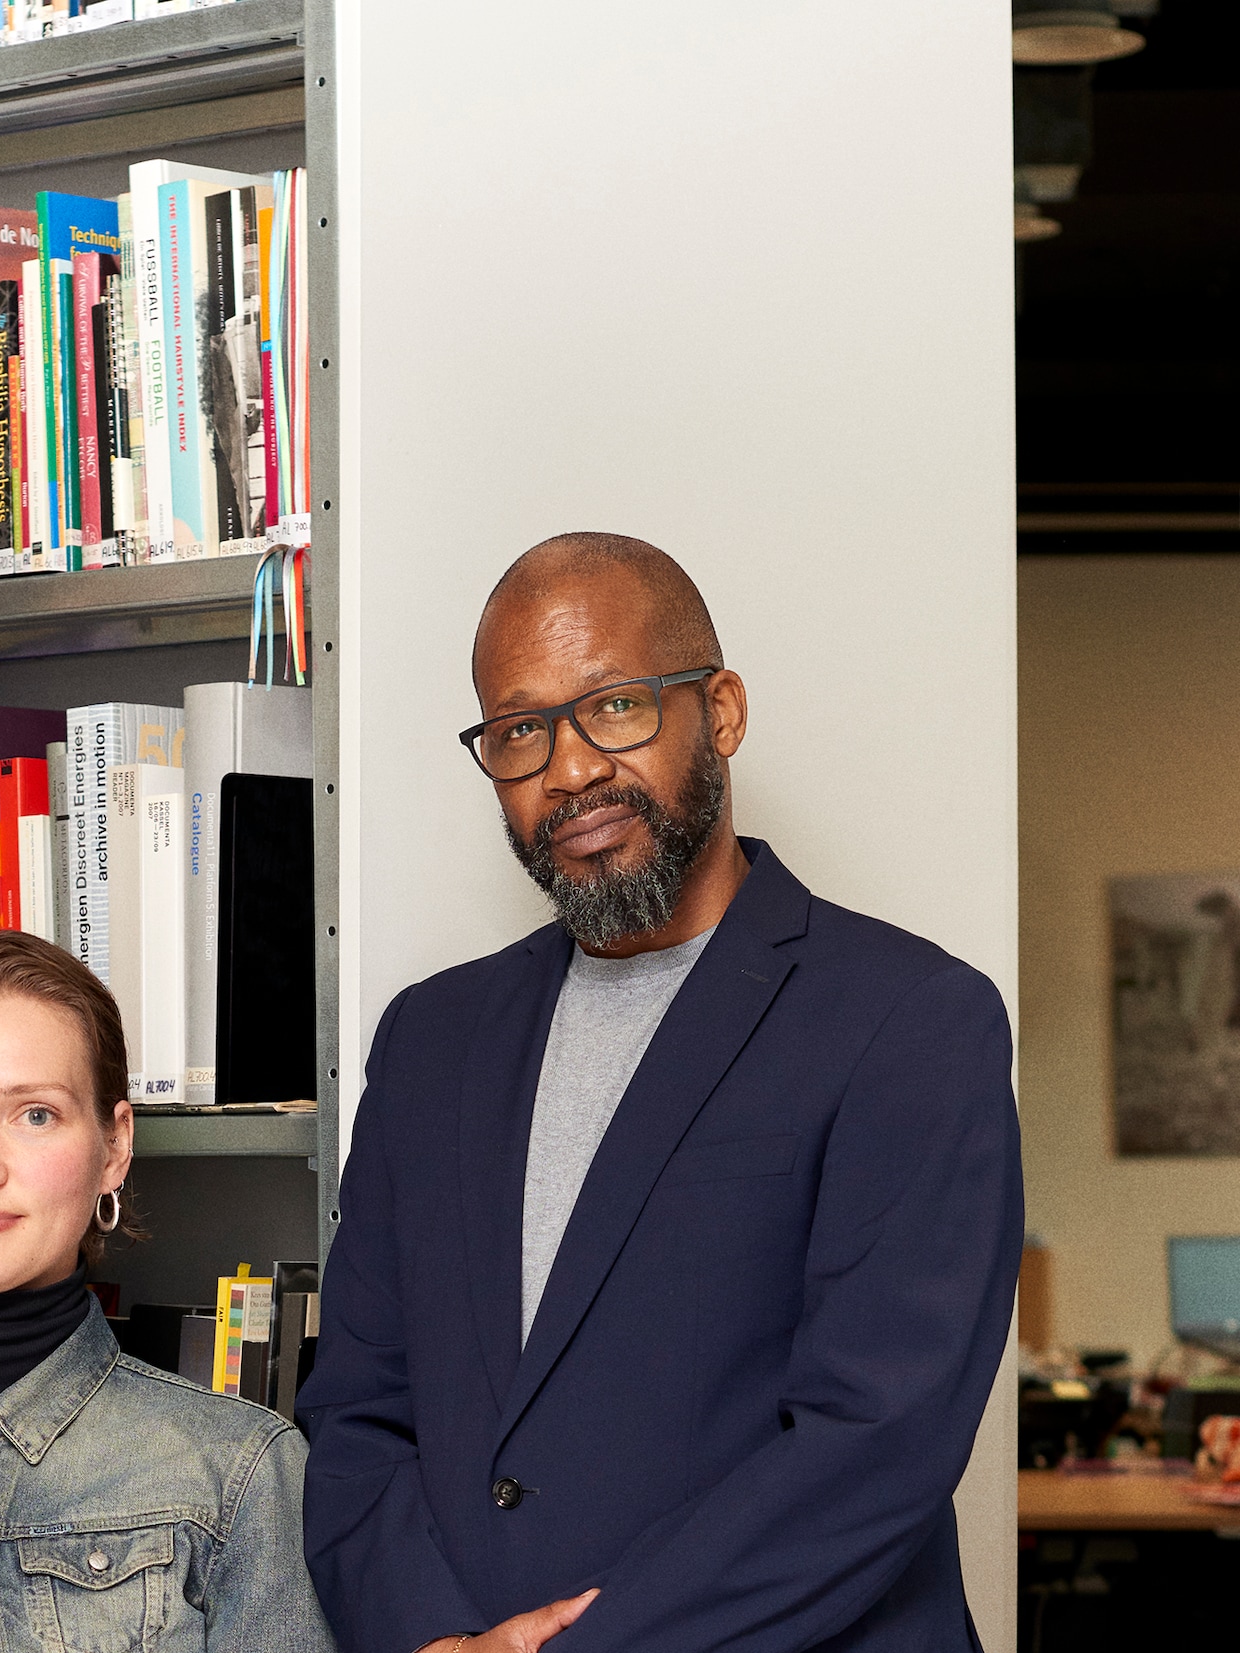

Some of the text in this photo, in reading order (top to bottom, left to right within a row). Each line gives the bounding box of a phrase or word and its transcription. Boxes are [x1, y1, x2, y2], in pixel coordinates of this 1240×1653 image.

[0, 223, 17, 245] de
[78, 262, 92, 417] SURVIVAL OF THE PRETTIEST
[145, 238, 165, 426] FUSSBALL FOOTBALL
[168, 195, 187, 453] THE INTERNATIONAL HAIRSTYLE INDEX
[86, 435, 97, 479] NANCY
[71, 725, 89, 807] Energies
[92, 722, 109, 881] archive in motion
[60, 823, 69, 895] METACORPOS
[73, 811, 88, 889] Discreet
[189, 792, 203, 876] Catalogue
[205, 915, 216, 961] Exhibition
[217, 1306, 225, 1323] FAIR
